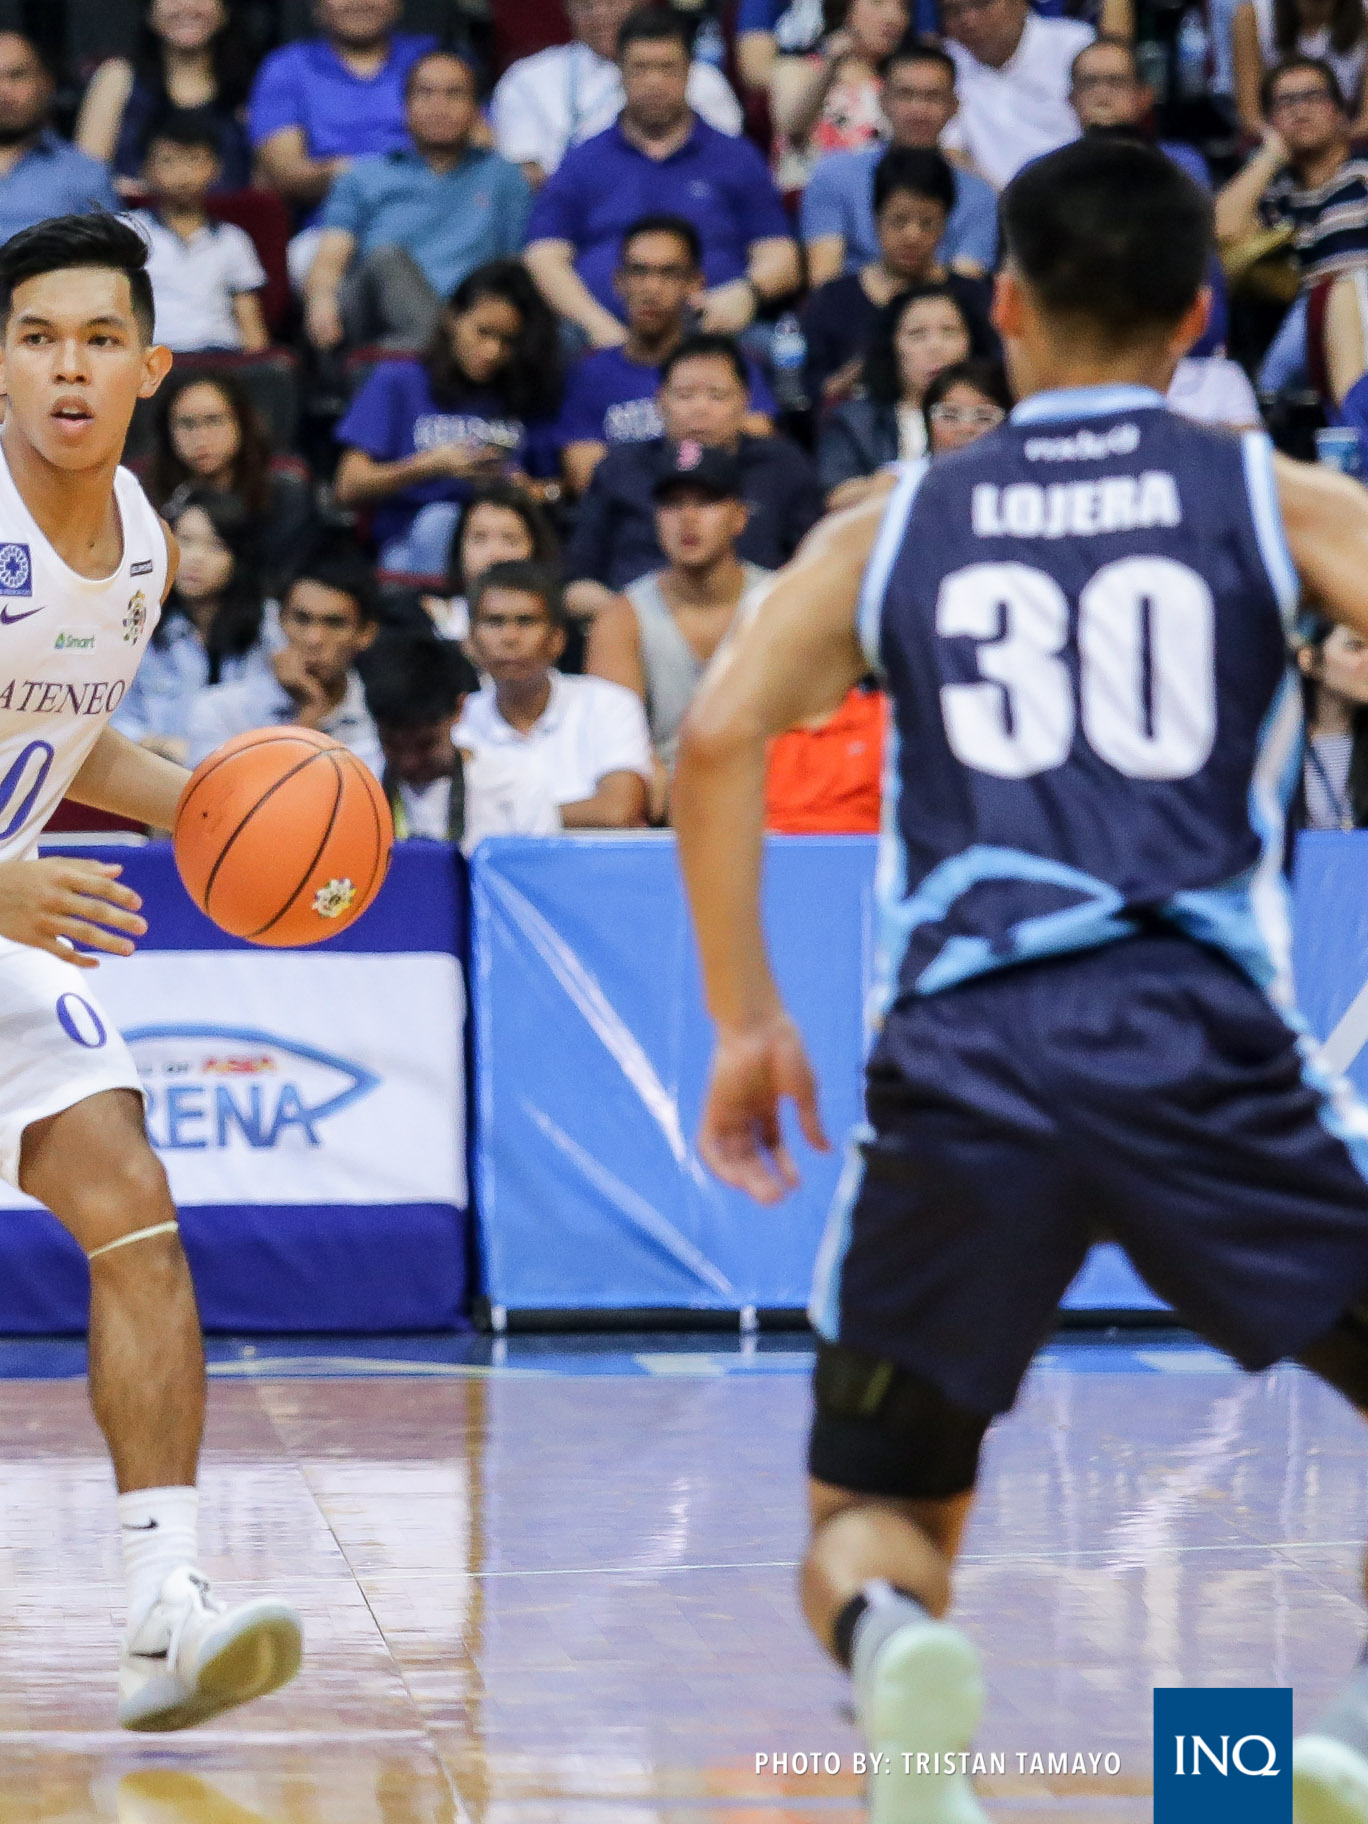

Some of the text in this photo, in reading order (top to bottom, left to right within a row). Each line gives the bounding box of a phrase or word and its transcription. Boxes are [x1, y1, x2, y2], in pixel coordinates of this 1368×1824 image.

[971, 469, 1181, 538] LOJERA
[66, 634, 95, 649] Smart
[935, 554, 1217, 781] 30
[56, 992, 107, 1049] 0
[146, 1083, 321, 1149] ENA
